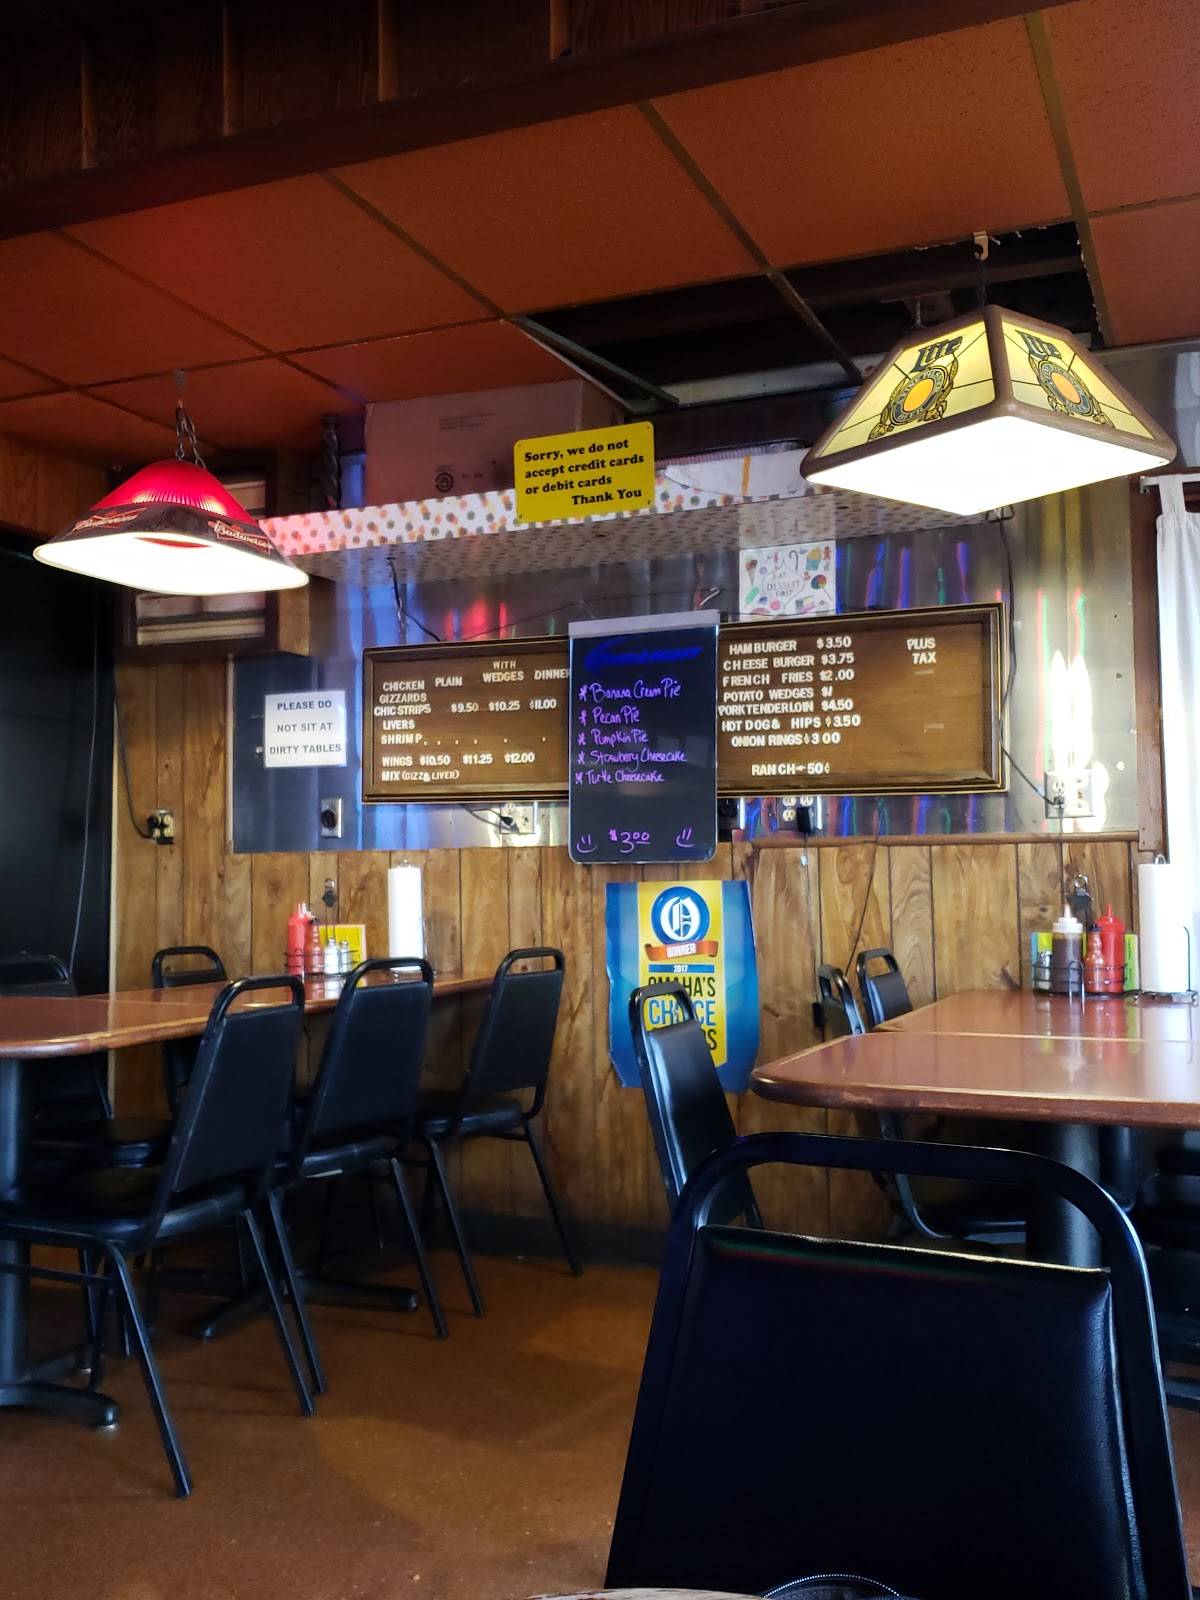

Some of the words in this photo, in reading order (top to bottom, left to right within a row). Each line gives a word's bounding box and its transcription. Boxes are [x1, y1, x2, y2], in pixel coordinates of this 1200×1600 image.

[524, 450, 563, 462] Sorry,
[567, 446, 585, 456] we
[588, 443, 604, 453] do
[607, 439, 630, 451] not
[525, 463, 565, 479] accept
[568, 458, 606, 473] credit
[609, 454, 644, 467] cards
[525, 486, 539, 495] or
[542, 480, 574, 493] debit
[578, 476, 612, 489] cards
[571, 491, 614, 506] Thank
[617, 488, 642, 500] You
[214, 522, 273, 550] Budweiser
[816, 636, 852, 649] $3.50
[907, 638, 936, 650] PLUS
[492, 660, 516, 670] WITH
[723, 657, 768, 671] CHEESE
[773, 655, 815, 668] BURGER
[821, 652, 854, 665] $3.75
[912, 652, 937, 664] TAX
[383, 680, 425, 692] CHICKEN
[435, 676, 463, 688] PLAIN
[482, 670, 524, 683] WEDGES
[722, 674, 770, 687] FRENCH
[781, 671, 813, 683] FRIES
[589, 682, 632, 703] Banana
[633, 679, 661, 699] Cream
[660, 677, 681, 700] Pie
[723, 690, 764, 703] POTATO
[768, 687, 814, 700] WEDGES
[277, 701, 315, 711] PLEASE
[318, 700, 332, 709] DO
[379, 692, 427, 704] GIZZARDS
[451, 702, 479, 713] $9.50
[488, 700, 520, 711] $10.25
[529, 698, 557, 710] $11.00
[821, 698, 854, 711] $4.50
[592, 706, 621, 724] Pecan
[620, 705, 640, 725] Pie
[277, 723, 297, 733] NOT
[300, 722, 316, 732] SIT
[320, 722, 333, 731] AT
[382, 719, 416, 730] LIVERS
[721, 720, 743, 732] HOT
[791, 716, 821, 729] HIPS
[825, 714, 861, 728] $3.50
[590, 728, 631, 748] Pumpkin
[631, 728, 649, 744] Pie
[731, 734, 765, 747] ONION
[768, 733, 803, 746] RINGS
[269, 745, 299, 755] DIRTY
[302, 743, 342, 753] TABLES
[382, 755, 413, 767] WINGS
[419, 754, 451, 766] $10.50
[462, 753, 493, 765] $11.25
[504, 752, 535, 764] $12.00
[381, 770, 400, 781] MIX
[585, 769, 613, 785] Turtle
[666, 942, 697, 958] WINNER
[673, 964, 688, 973] 2017
[648, 999, 717, 1026] CHCE
